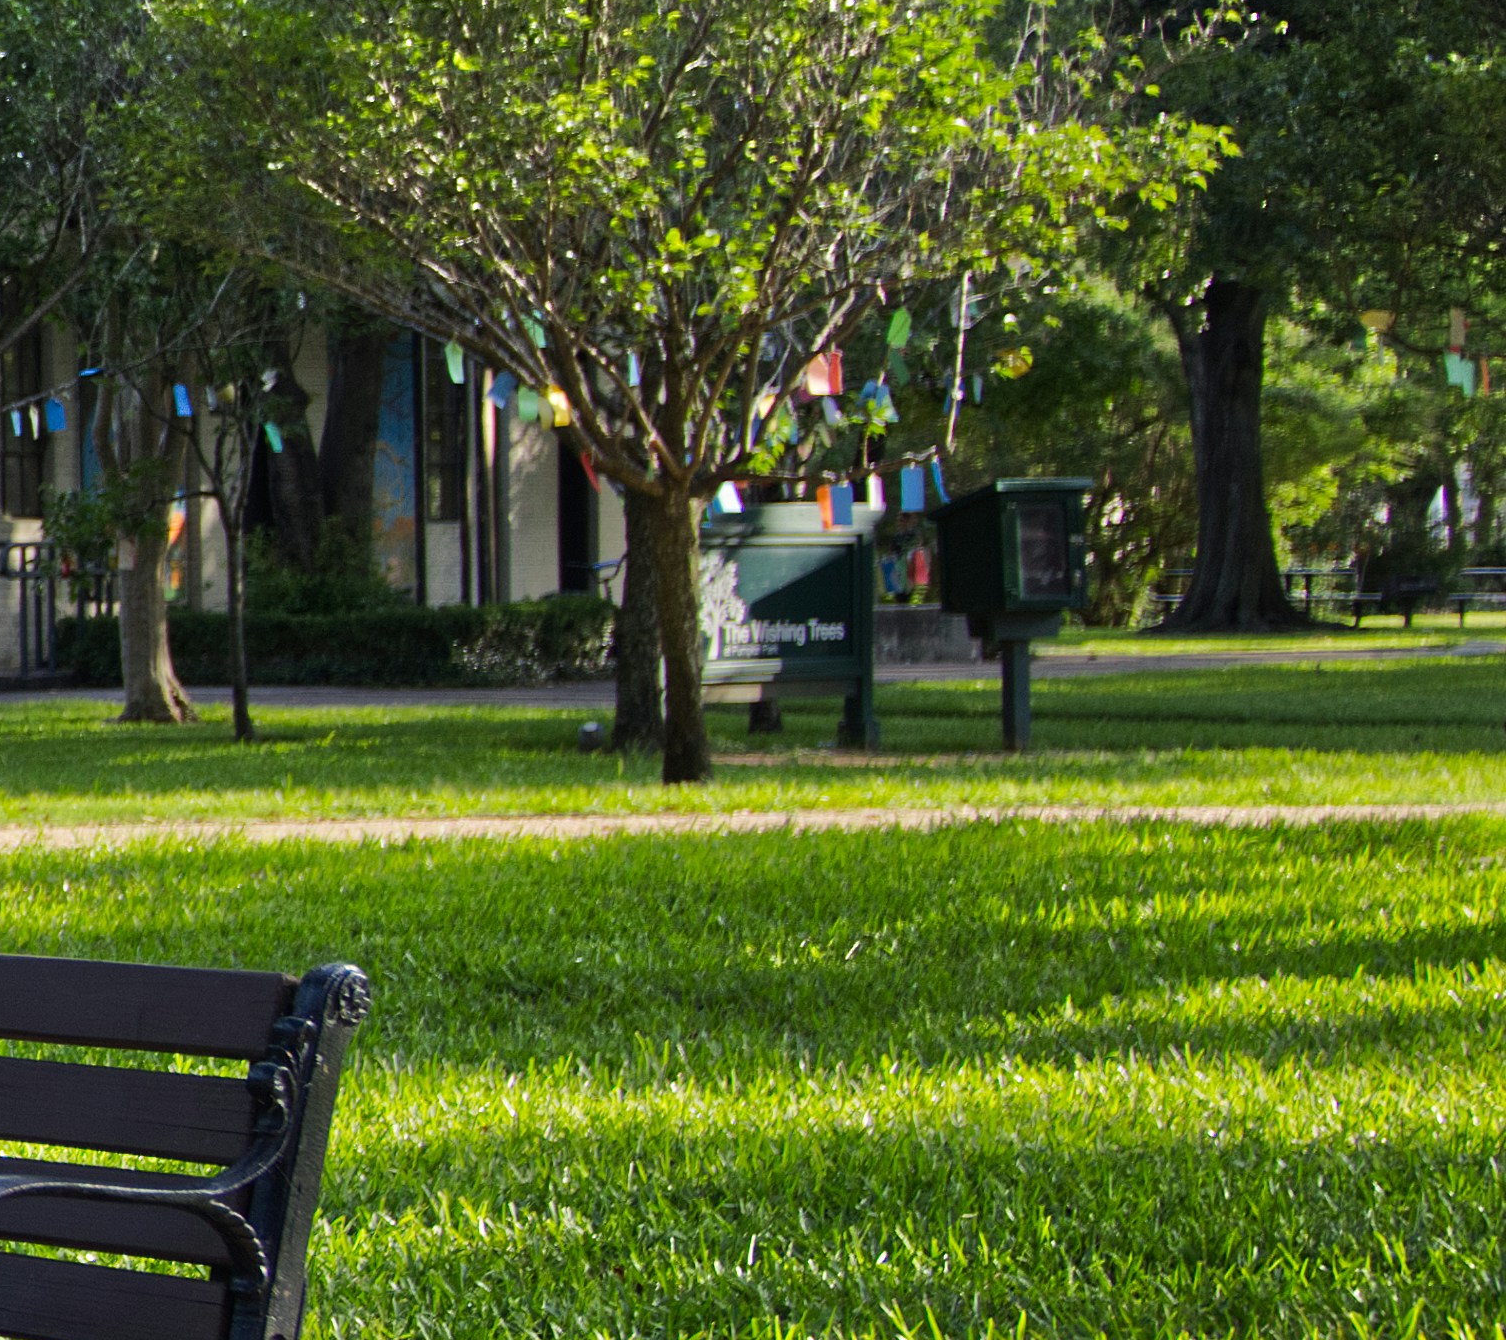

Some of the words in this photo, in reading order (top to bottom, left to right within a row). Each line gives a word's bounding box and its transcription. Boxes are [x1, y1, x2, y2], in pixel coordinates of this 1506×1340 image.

[725, 621, 749, 644] The
[751, 619, 807, 646] Wishing
[808, 618, 844, 640] Trees
